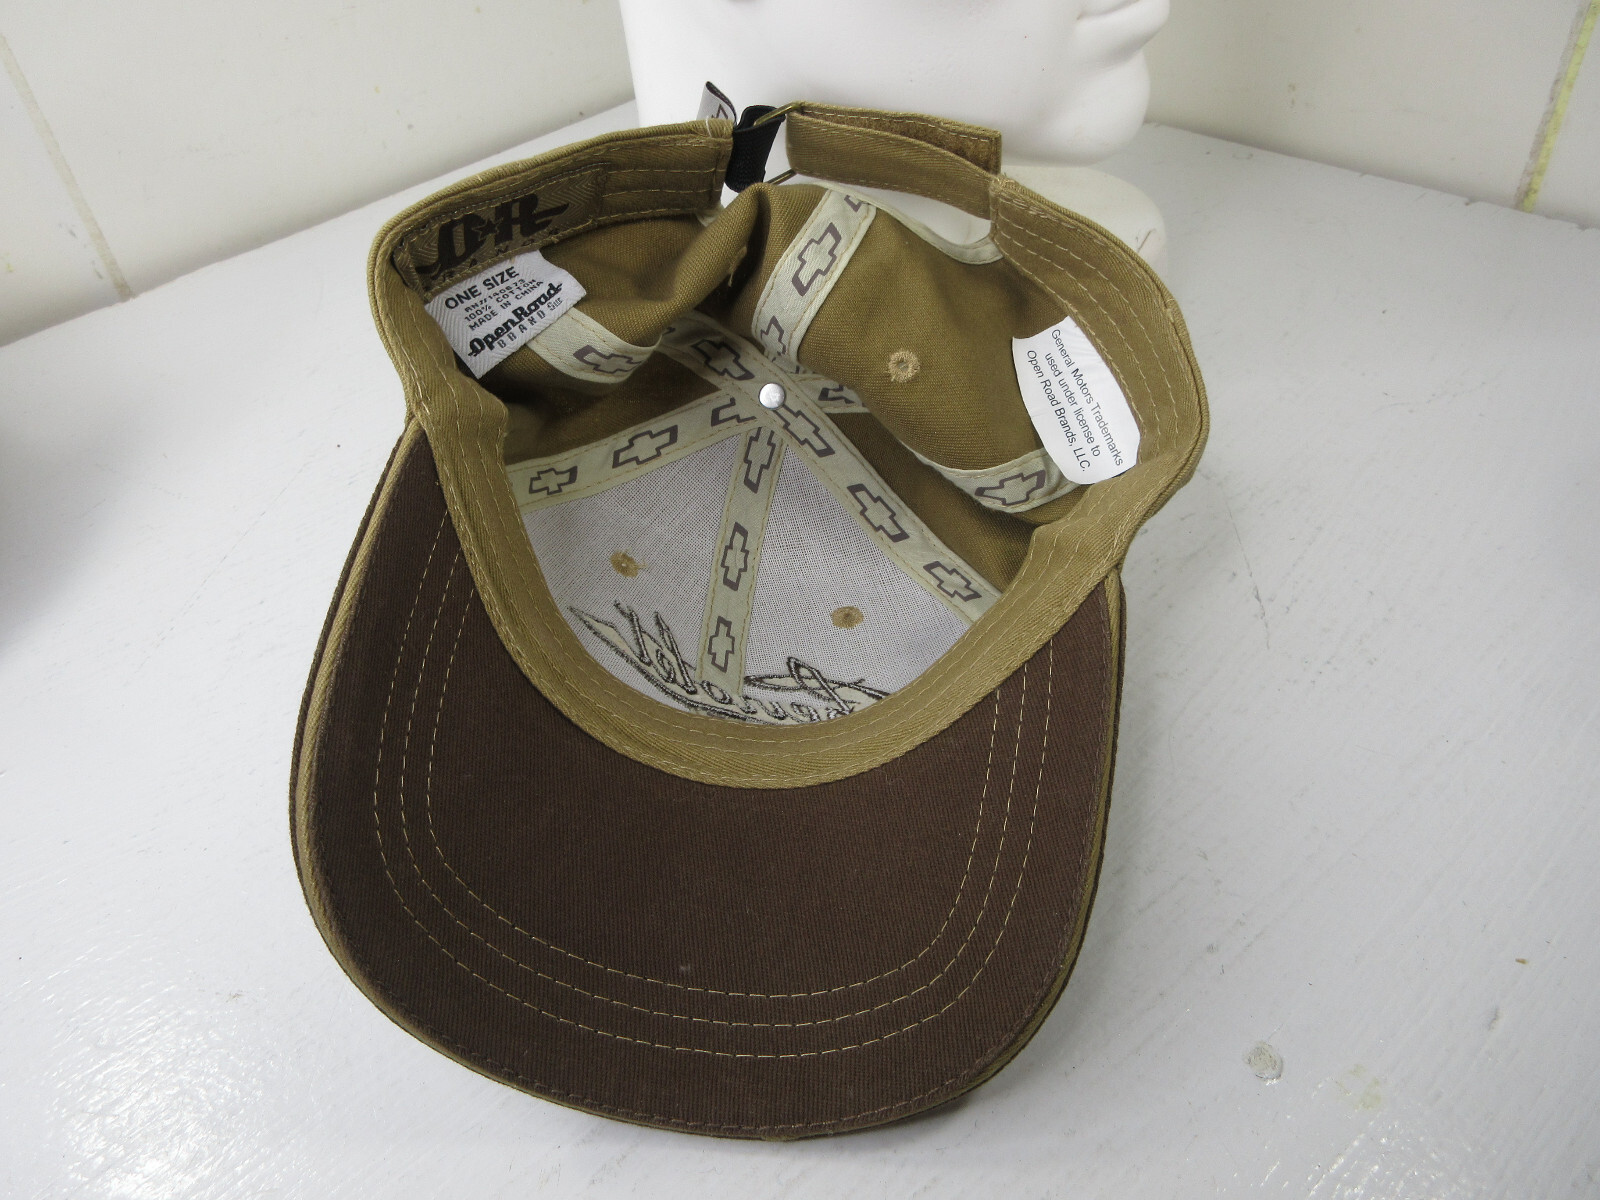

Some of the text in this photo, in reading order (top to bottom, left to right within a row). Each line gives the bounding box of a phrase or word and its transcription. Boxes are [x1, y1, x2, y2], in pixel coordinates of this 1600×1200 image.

[445, 266, 519, 309] ONE SIZE
[465, 279, 536, 321] 100% COTTON
[469, 281, 544, 331] MADE IN CHINA
[1027, 350, 1091, 472] Open Road Brands, LLC.
[1045, 352, 1101, 457] used under license to
[1051, 329, 1124, 466] General Motors Trademarks
